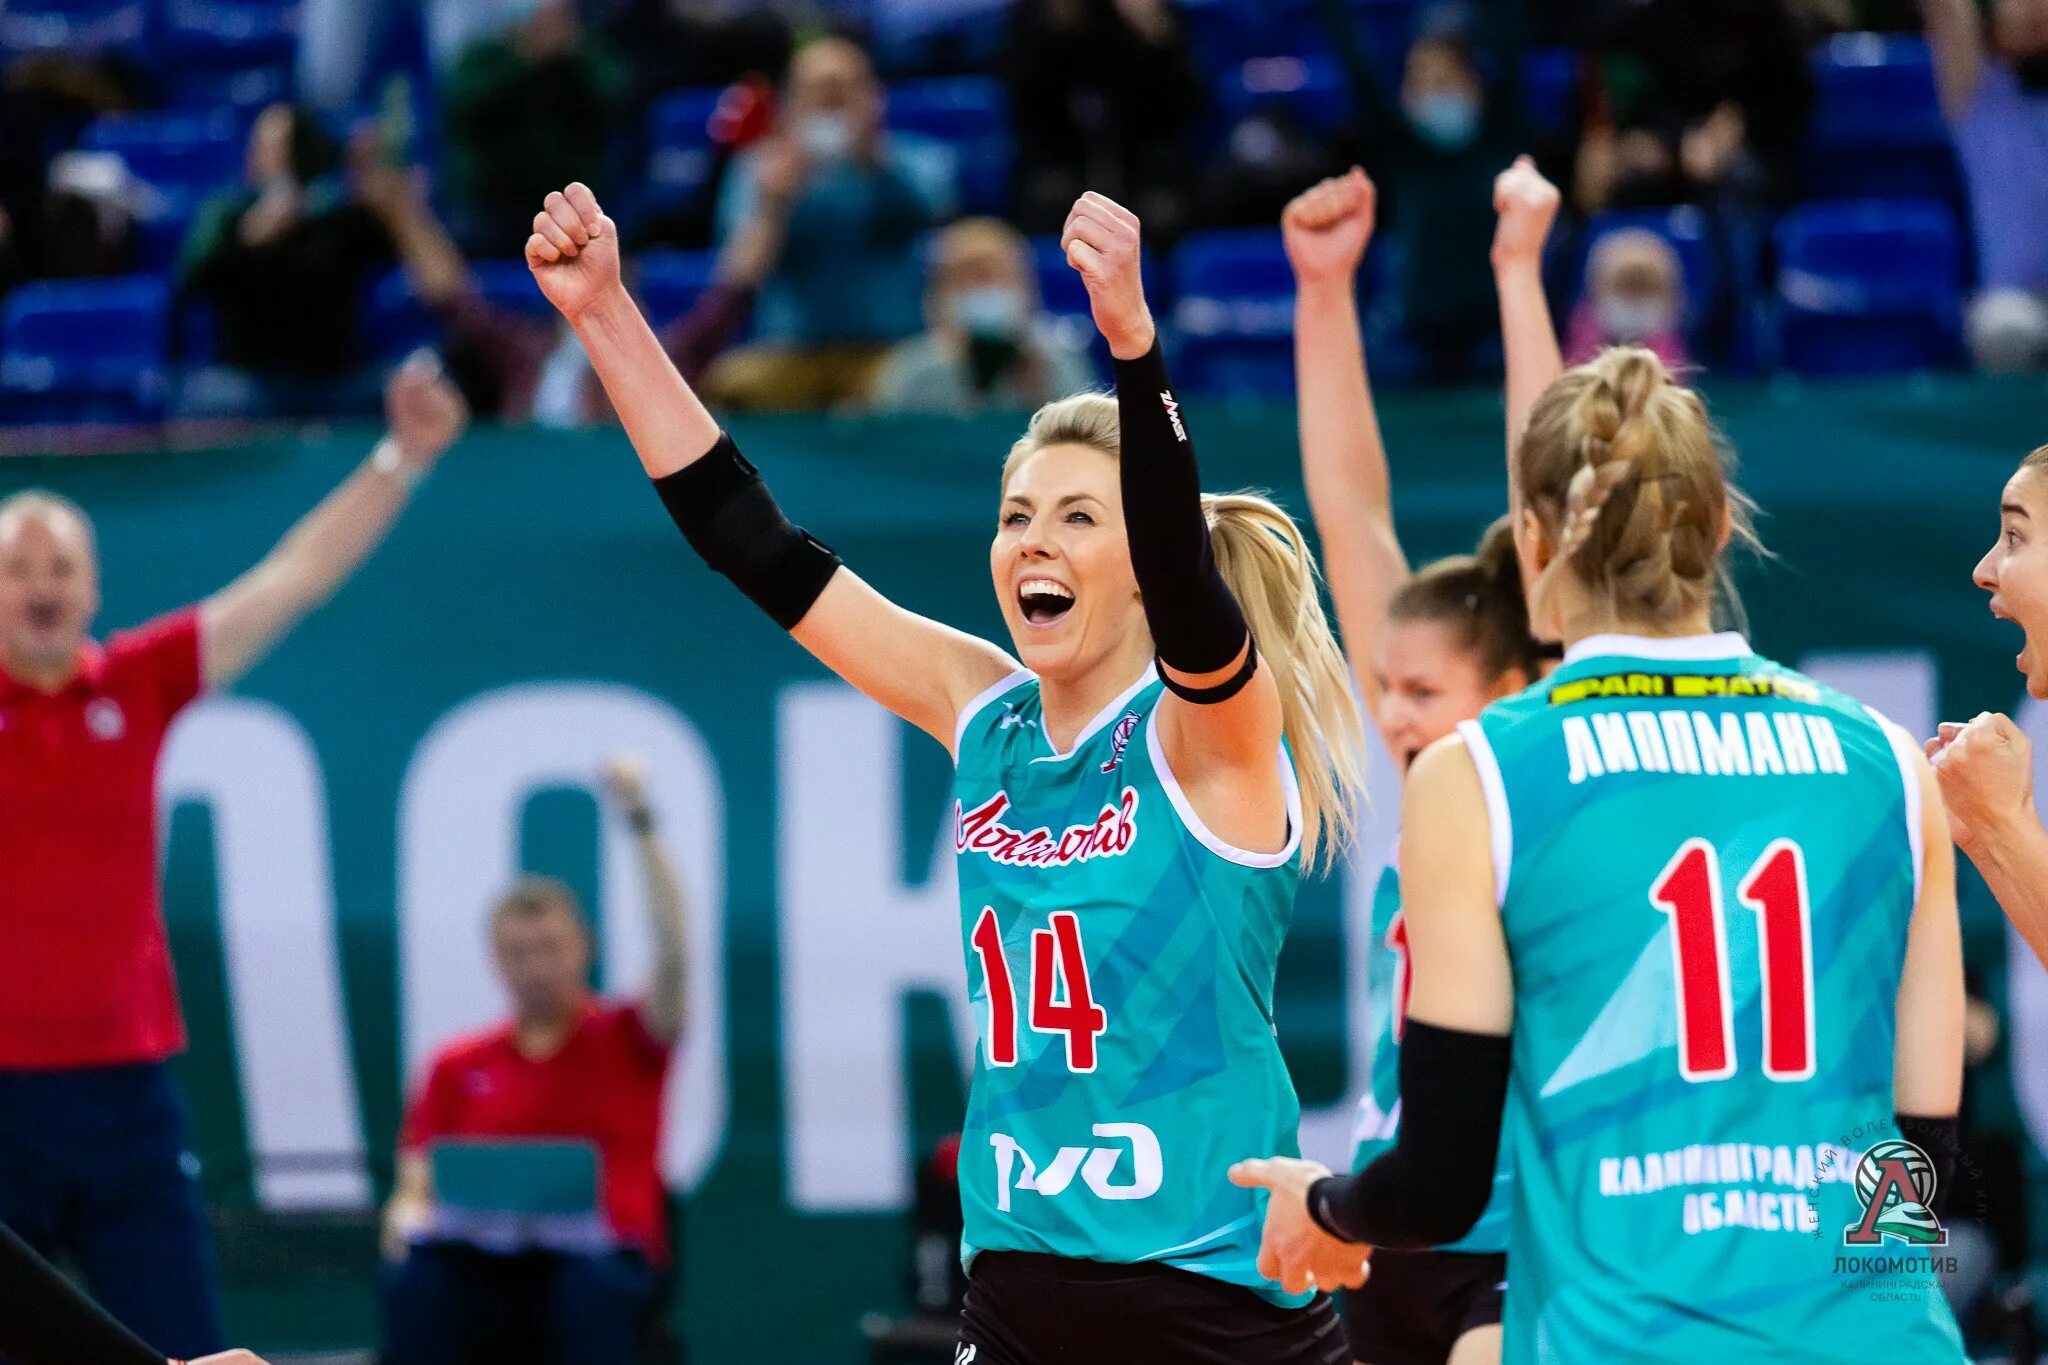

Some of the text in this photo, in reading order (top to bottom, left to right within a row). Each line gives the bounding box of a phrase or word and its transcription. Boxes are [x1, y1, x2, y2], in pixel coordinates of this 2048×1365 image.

[1160, 389, 1188, 442] ZAMST
[1690, 675, 1821, 703] MAT
[1562, 710, 1848, 784] ЛИППМАНН
[1649, 836, 1817, 1083] 11
[972, 906, 1107, 1073] 14
[1600, 1143, 1858, 1197] КАЛИНИНГРАДСК
[1683, 1190, 1818, 1234] ОБЛАСТЬ
